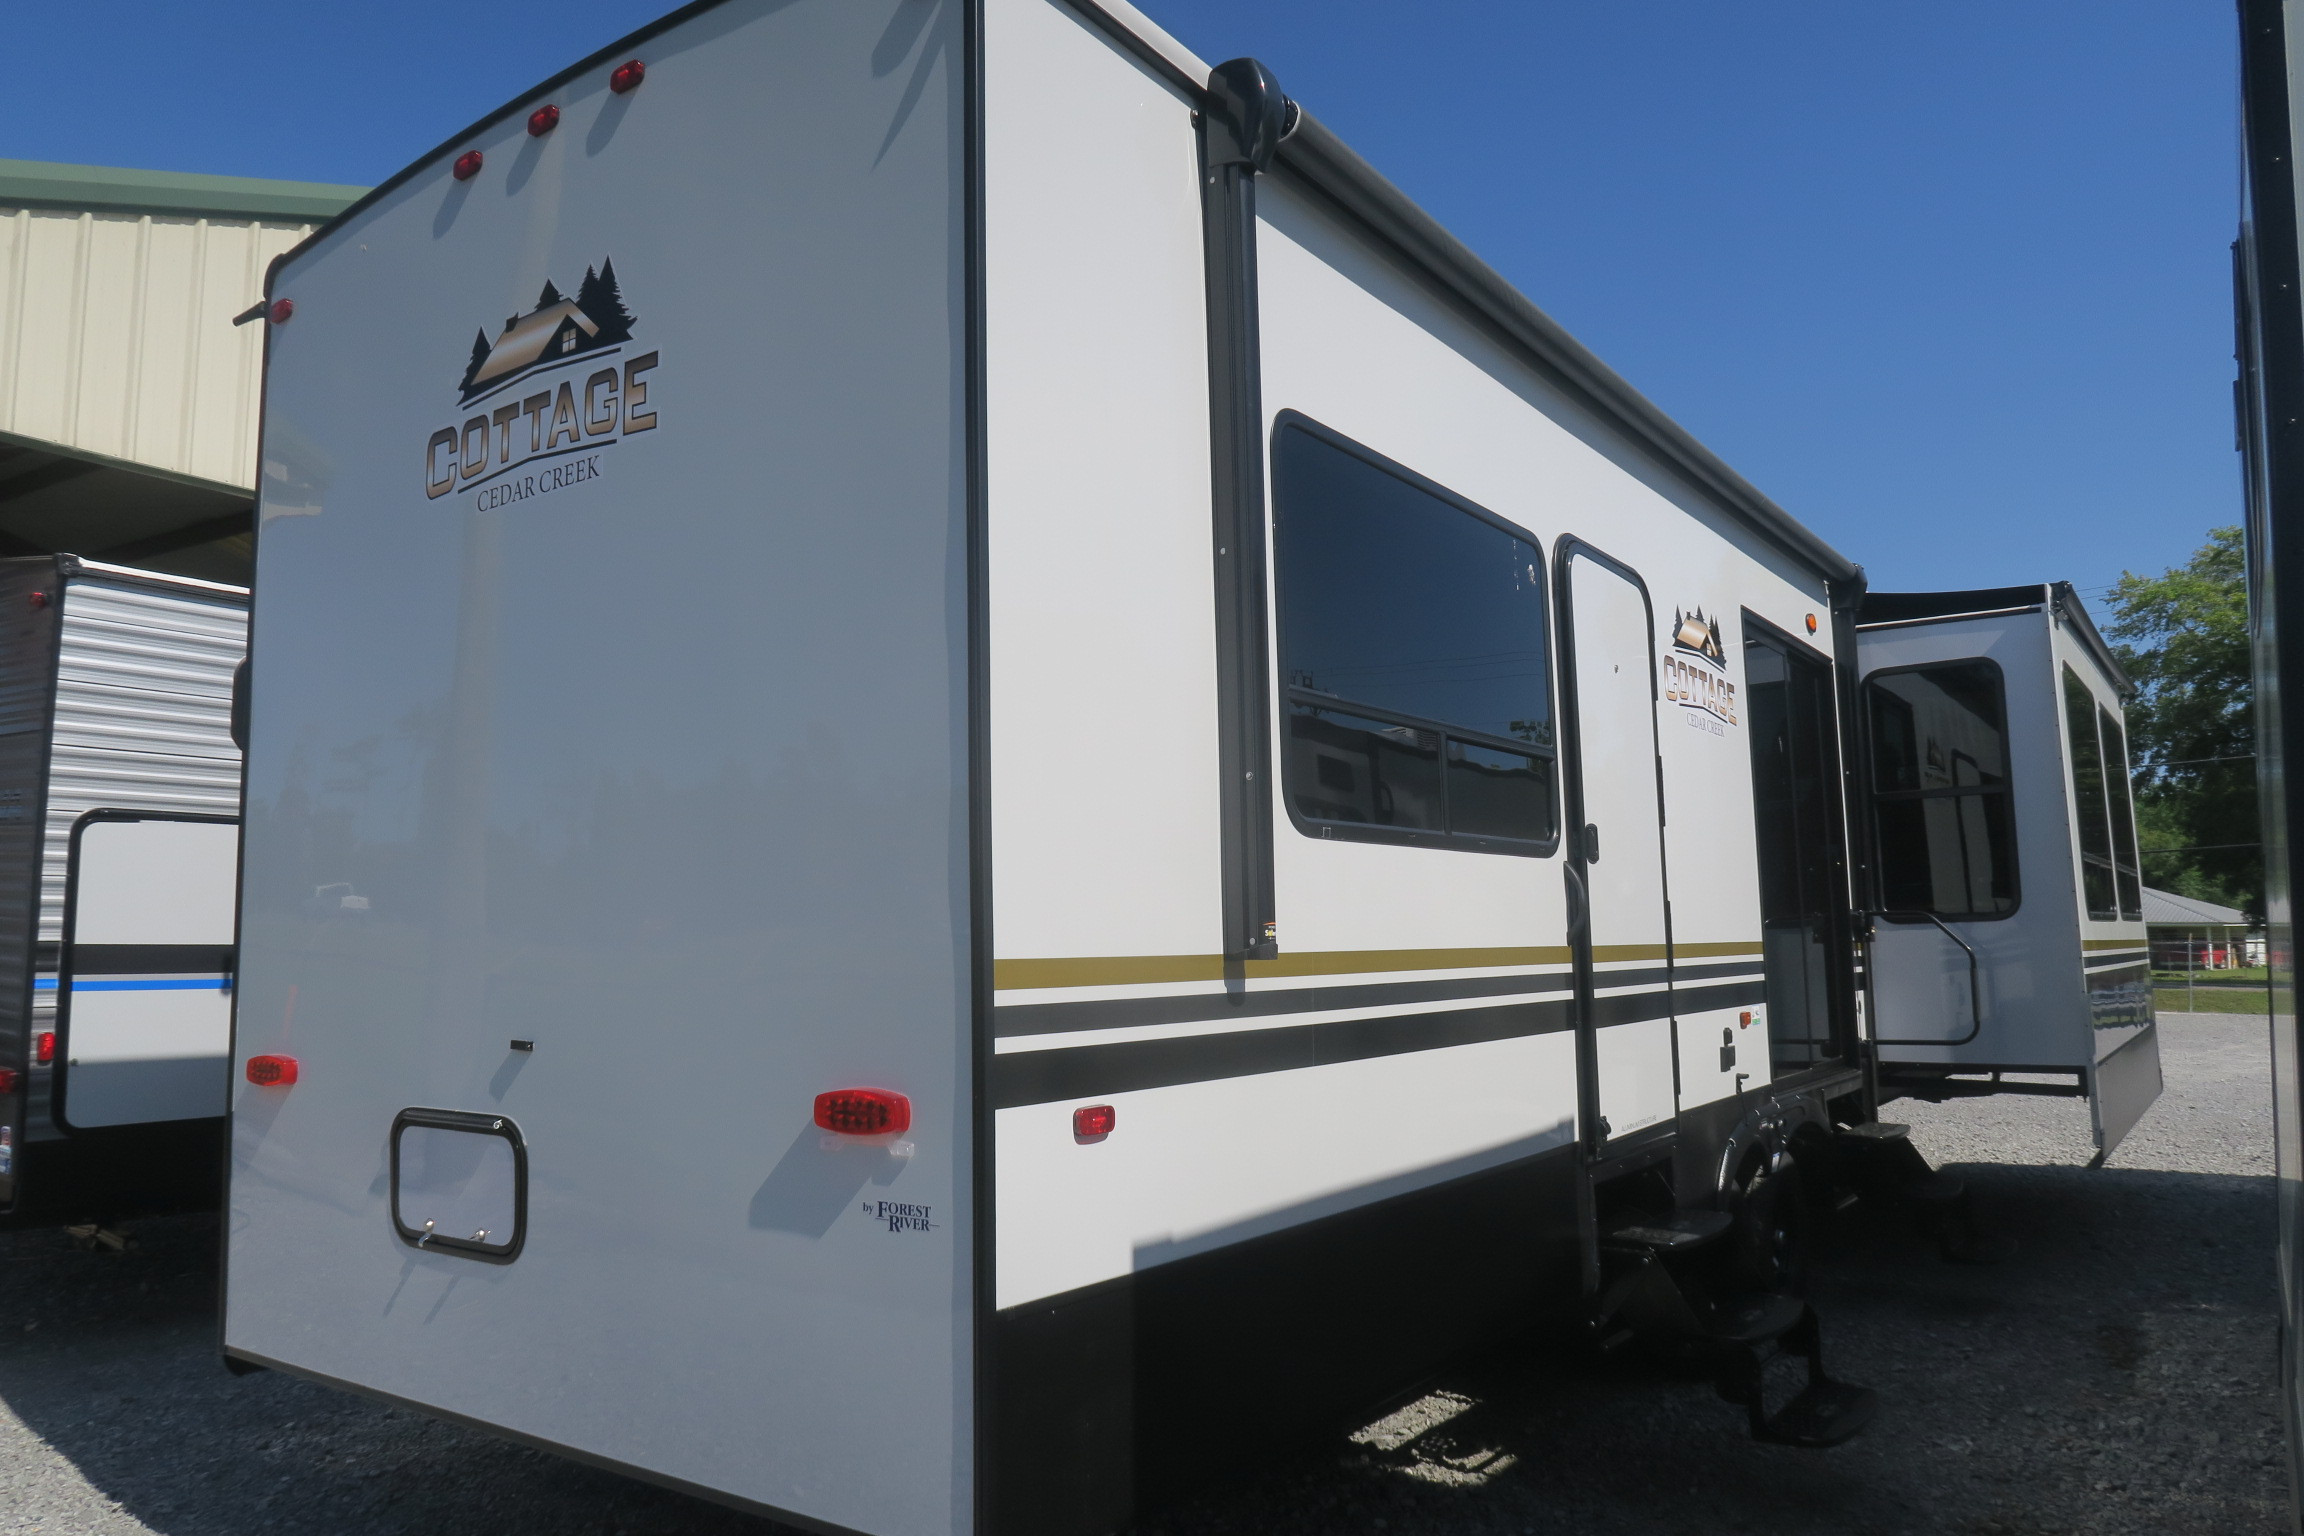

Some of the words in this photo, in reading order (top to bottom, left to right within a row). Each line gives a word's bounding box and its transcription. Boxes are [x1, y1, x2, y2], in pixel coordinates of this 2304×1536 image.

[426, 350, 659, 500] COTTAGE
[477, 476, 536, 512] CEDAR
[539, 455, 600, 494] CREEK
[1663, 654, 1737, 726] COTTAGE
[1687, 712, 1706, 732] CEDAR
[1706, 718, 1725, 737] CREEK
[863, 1202, 874, 1214] by
[877, 1200, 931, 1218] FOREST
[888, 1214, 930, 1233] RIVER
